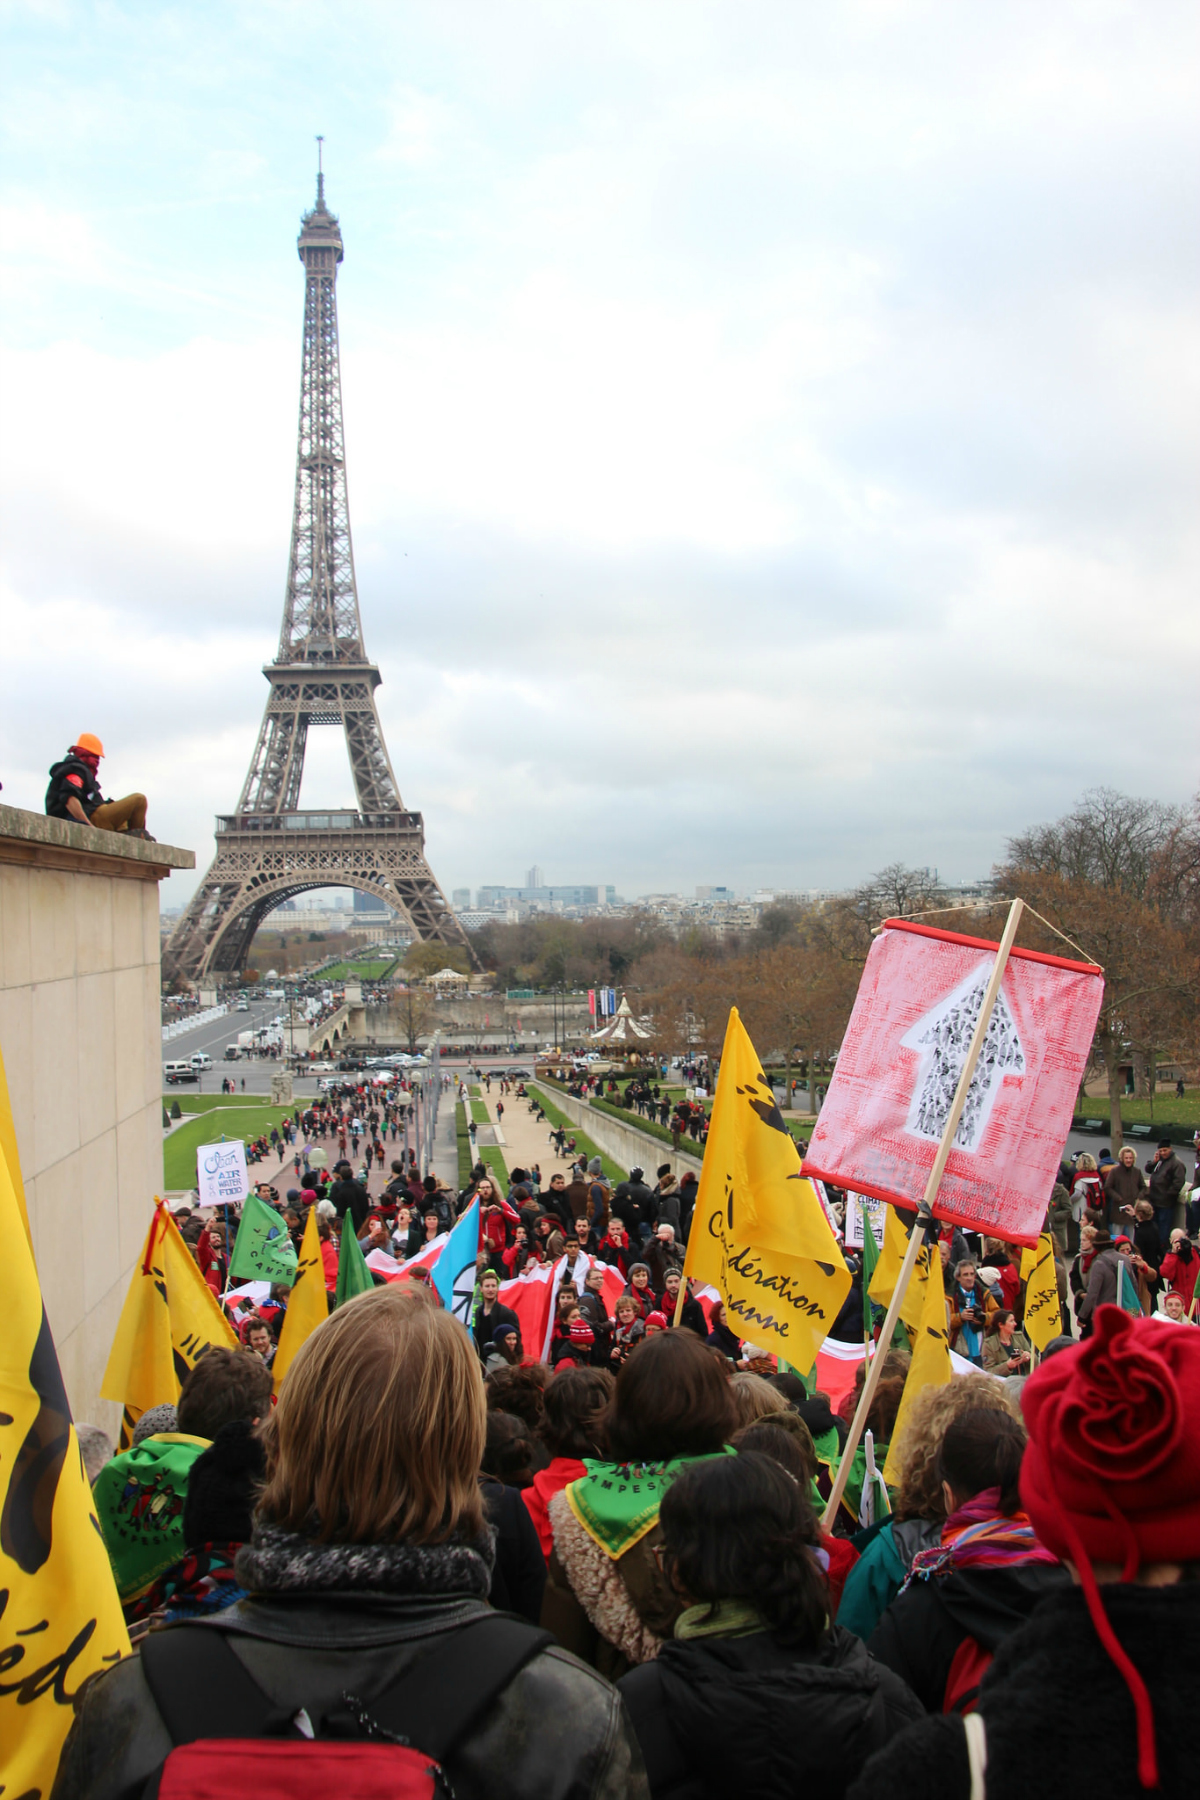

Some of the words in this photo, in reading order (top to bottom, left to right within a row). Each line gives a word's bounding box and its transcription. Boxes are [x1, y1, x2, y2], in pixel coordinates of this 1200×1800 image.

[204, 1150, 239, 1174] Clean
[218, 1169, 240, 1180] AIR
[218, 1178, 242, 1188] WATER
[219, 1187, 243, 1196] FOOD
[250, 1250, 293, 1276] CAMPE
